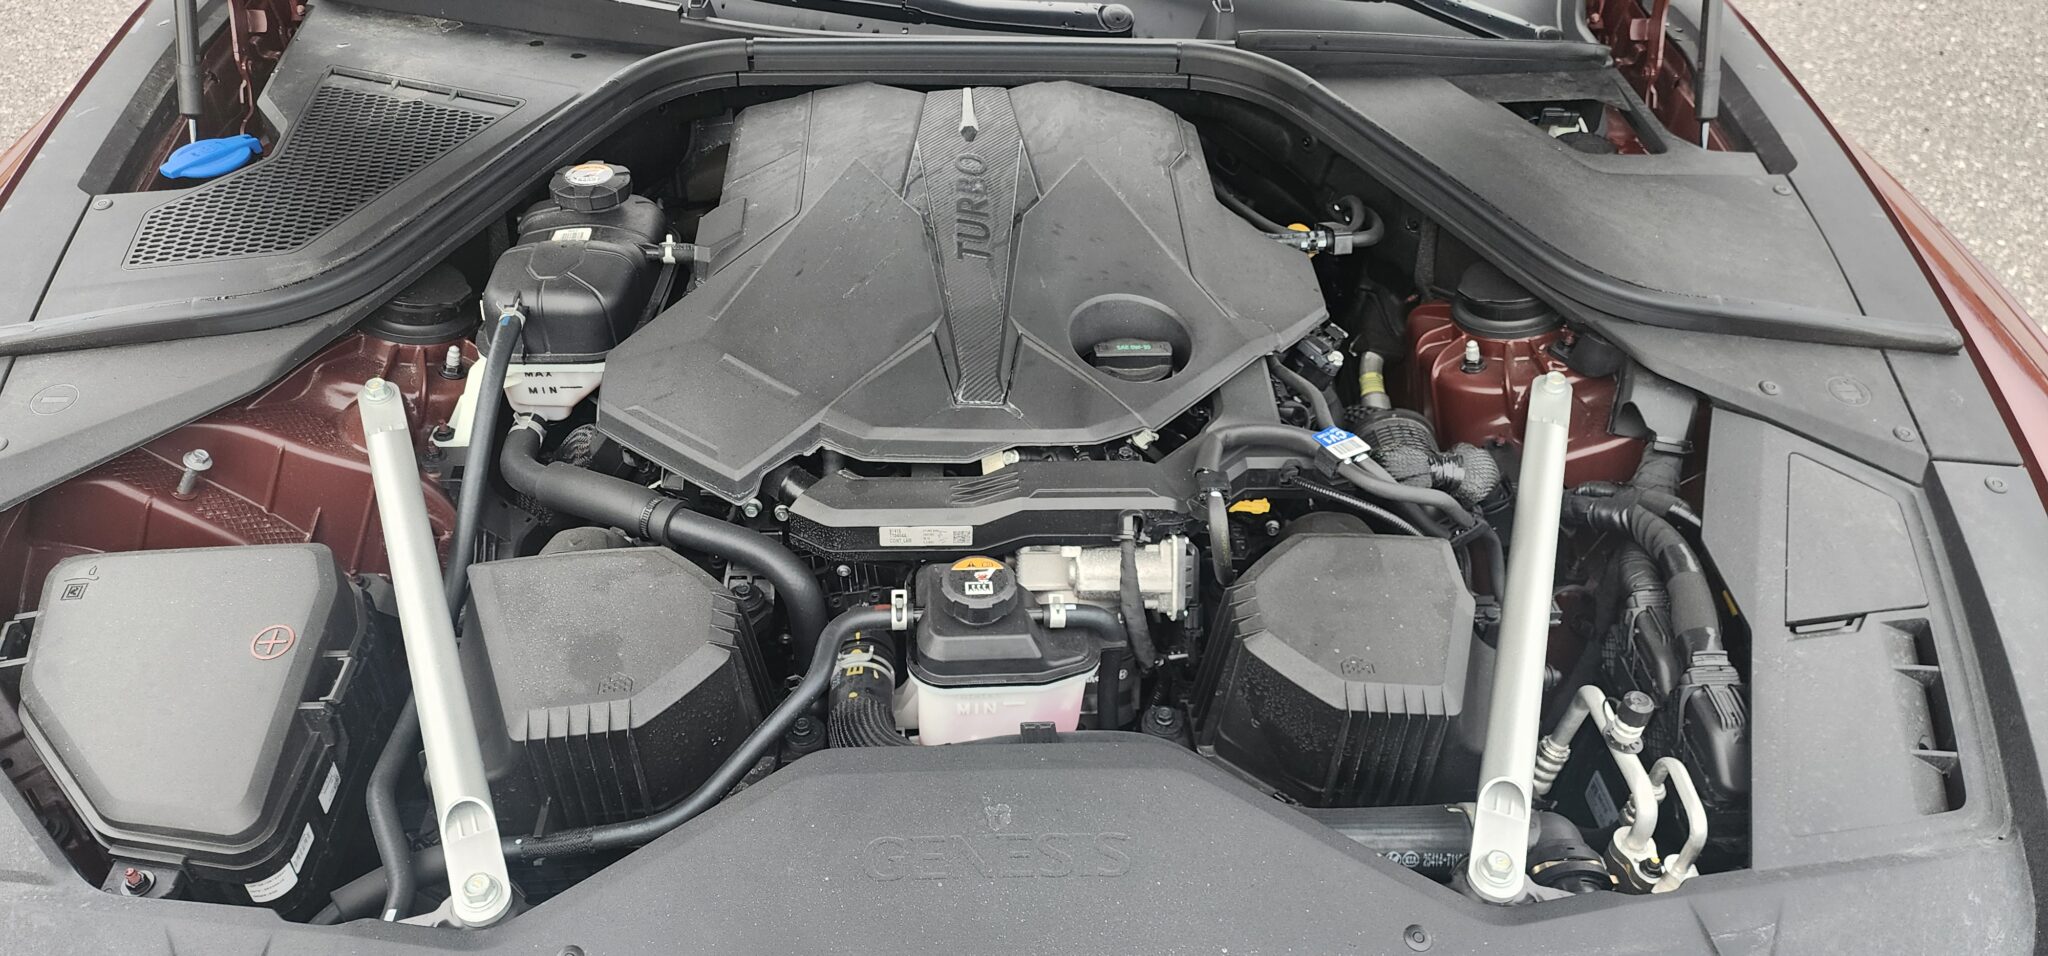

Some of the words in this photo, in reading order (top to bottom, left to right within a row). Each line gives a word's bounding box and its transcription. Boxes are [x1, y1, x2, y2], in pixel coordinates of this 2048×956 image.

[954, 153, 992, 260] TURBO
[528, 386, 558, 395] MIN
[1322, 430, 1348, 445] CV1
[956, 702, 997, 715] MIN
[863, 831, 1131, 882] GENESIS
